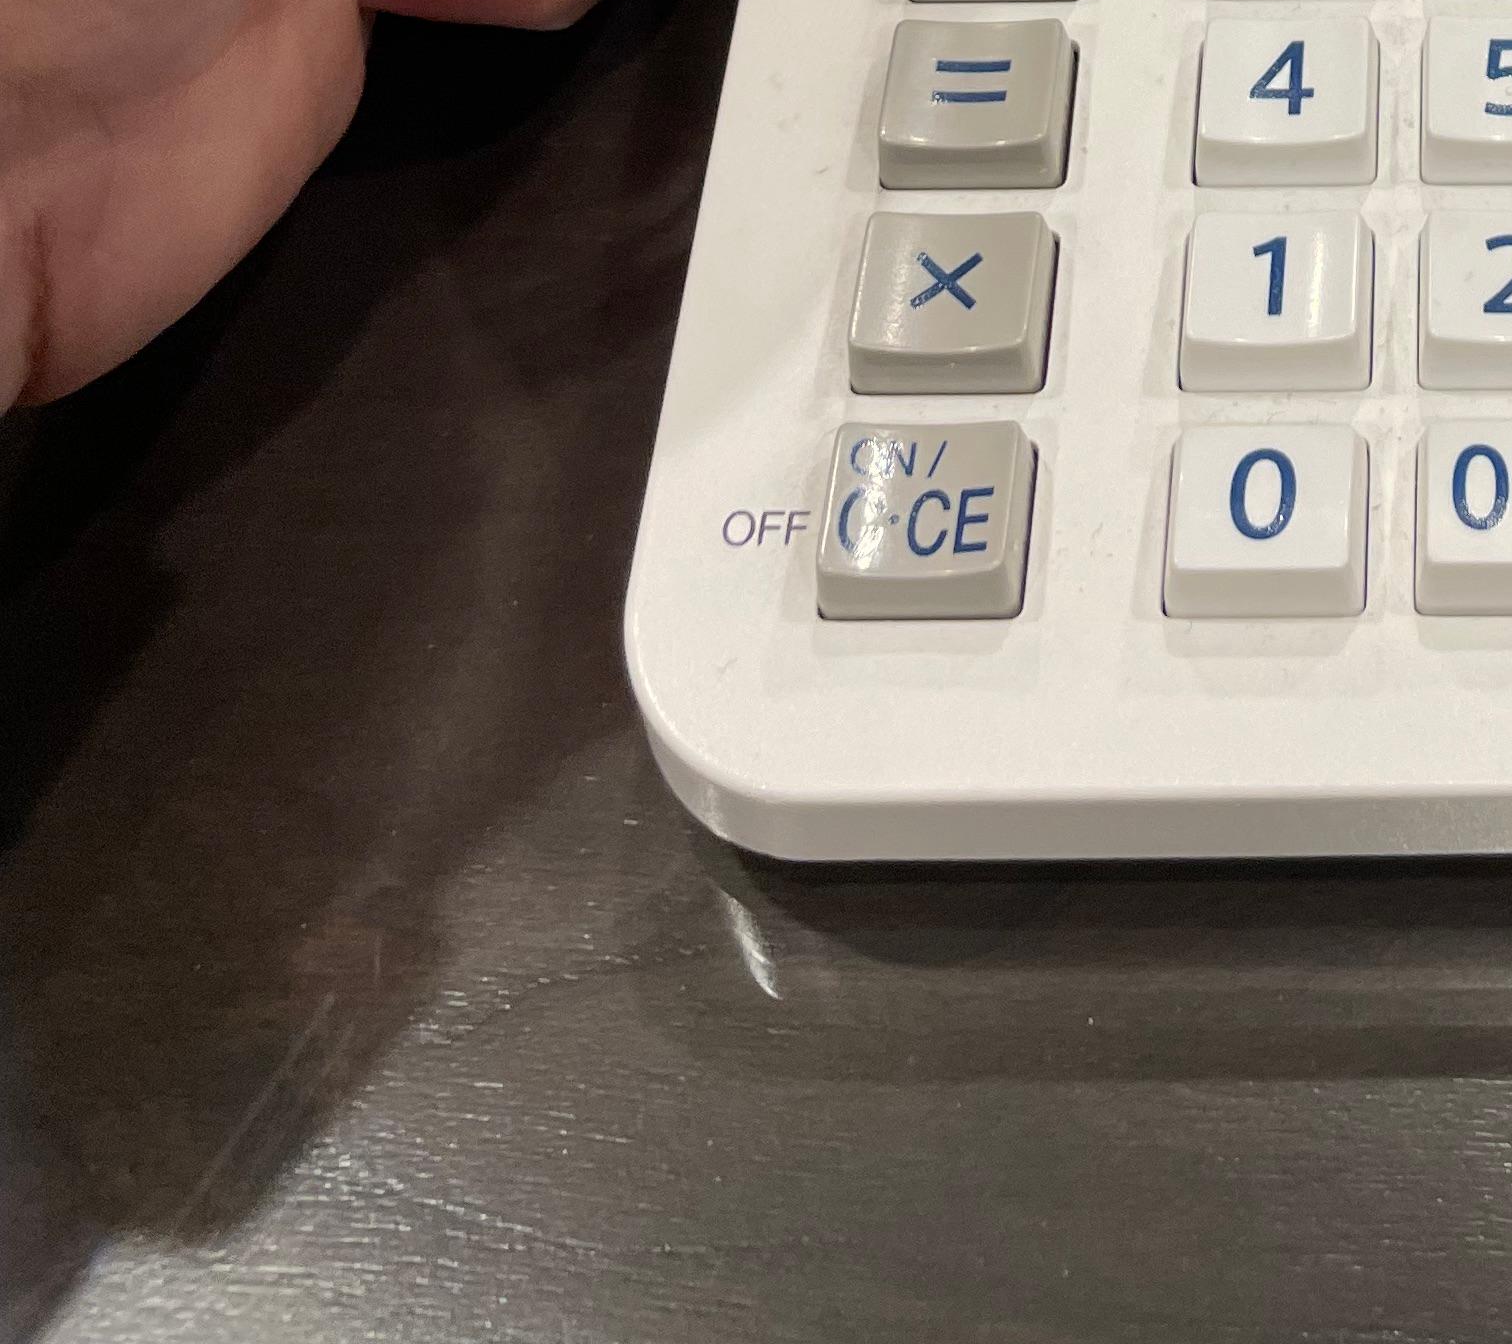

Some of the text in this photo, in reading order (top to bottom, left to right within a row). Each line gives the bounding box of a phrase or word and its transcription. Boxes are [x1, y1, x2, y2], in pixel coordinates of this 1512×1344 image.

[1249, 40, 1315, 116] 4
[1251, 235, 1289, 317] 1
[722, 510, 811, 547] OFF
[1228, 447, 1297, 541] 0
